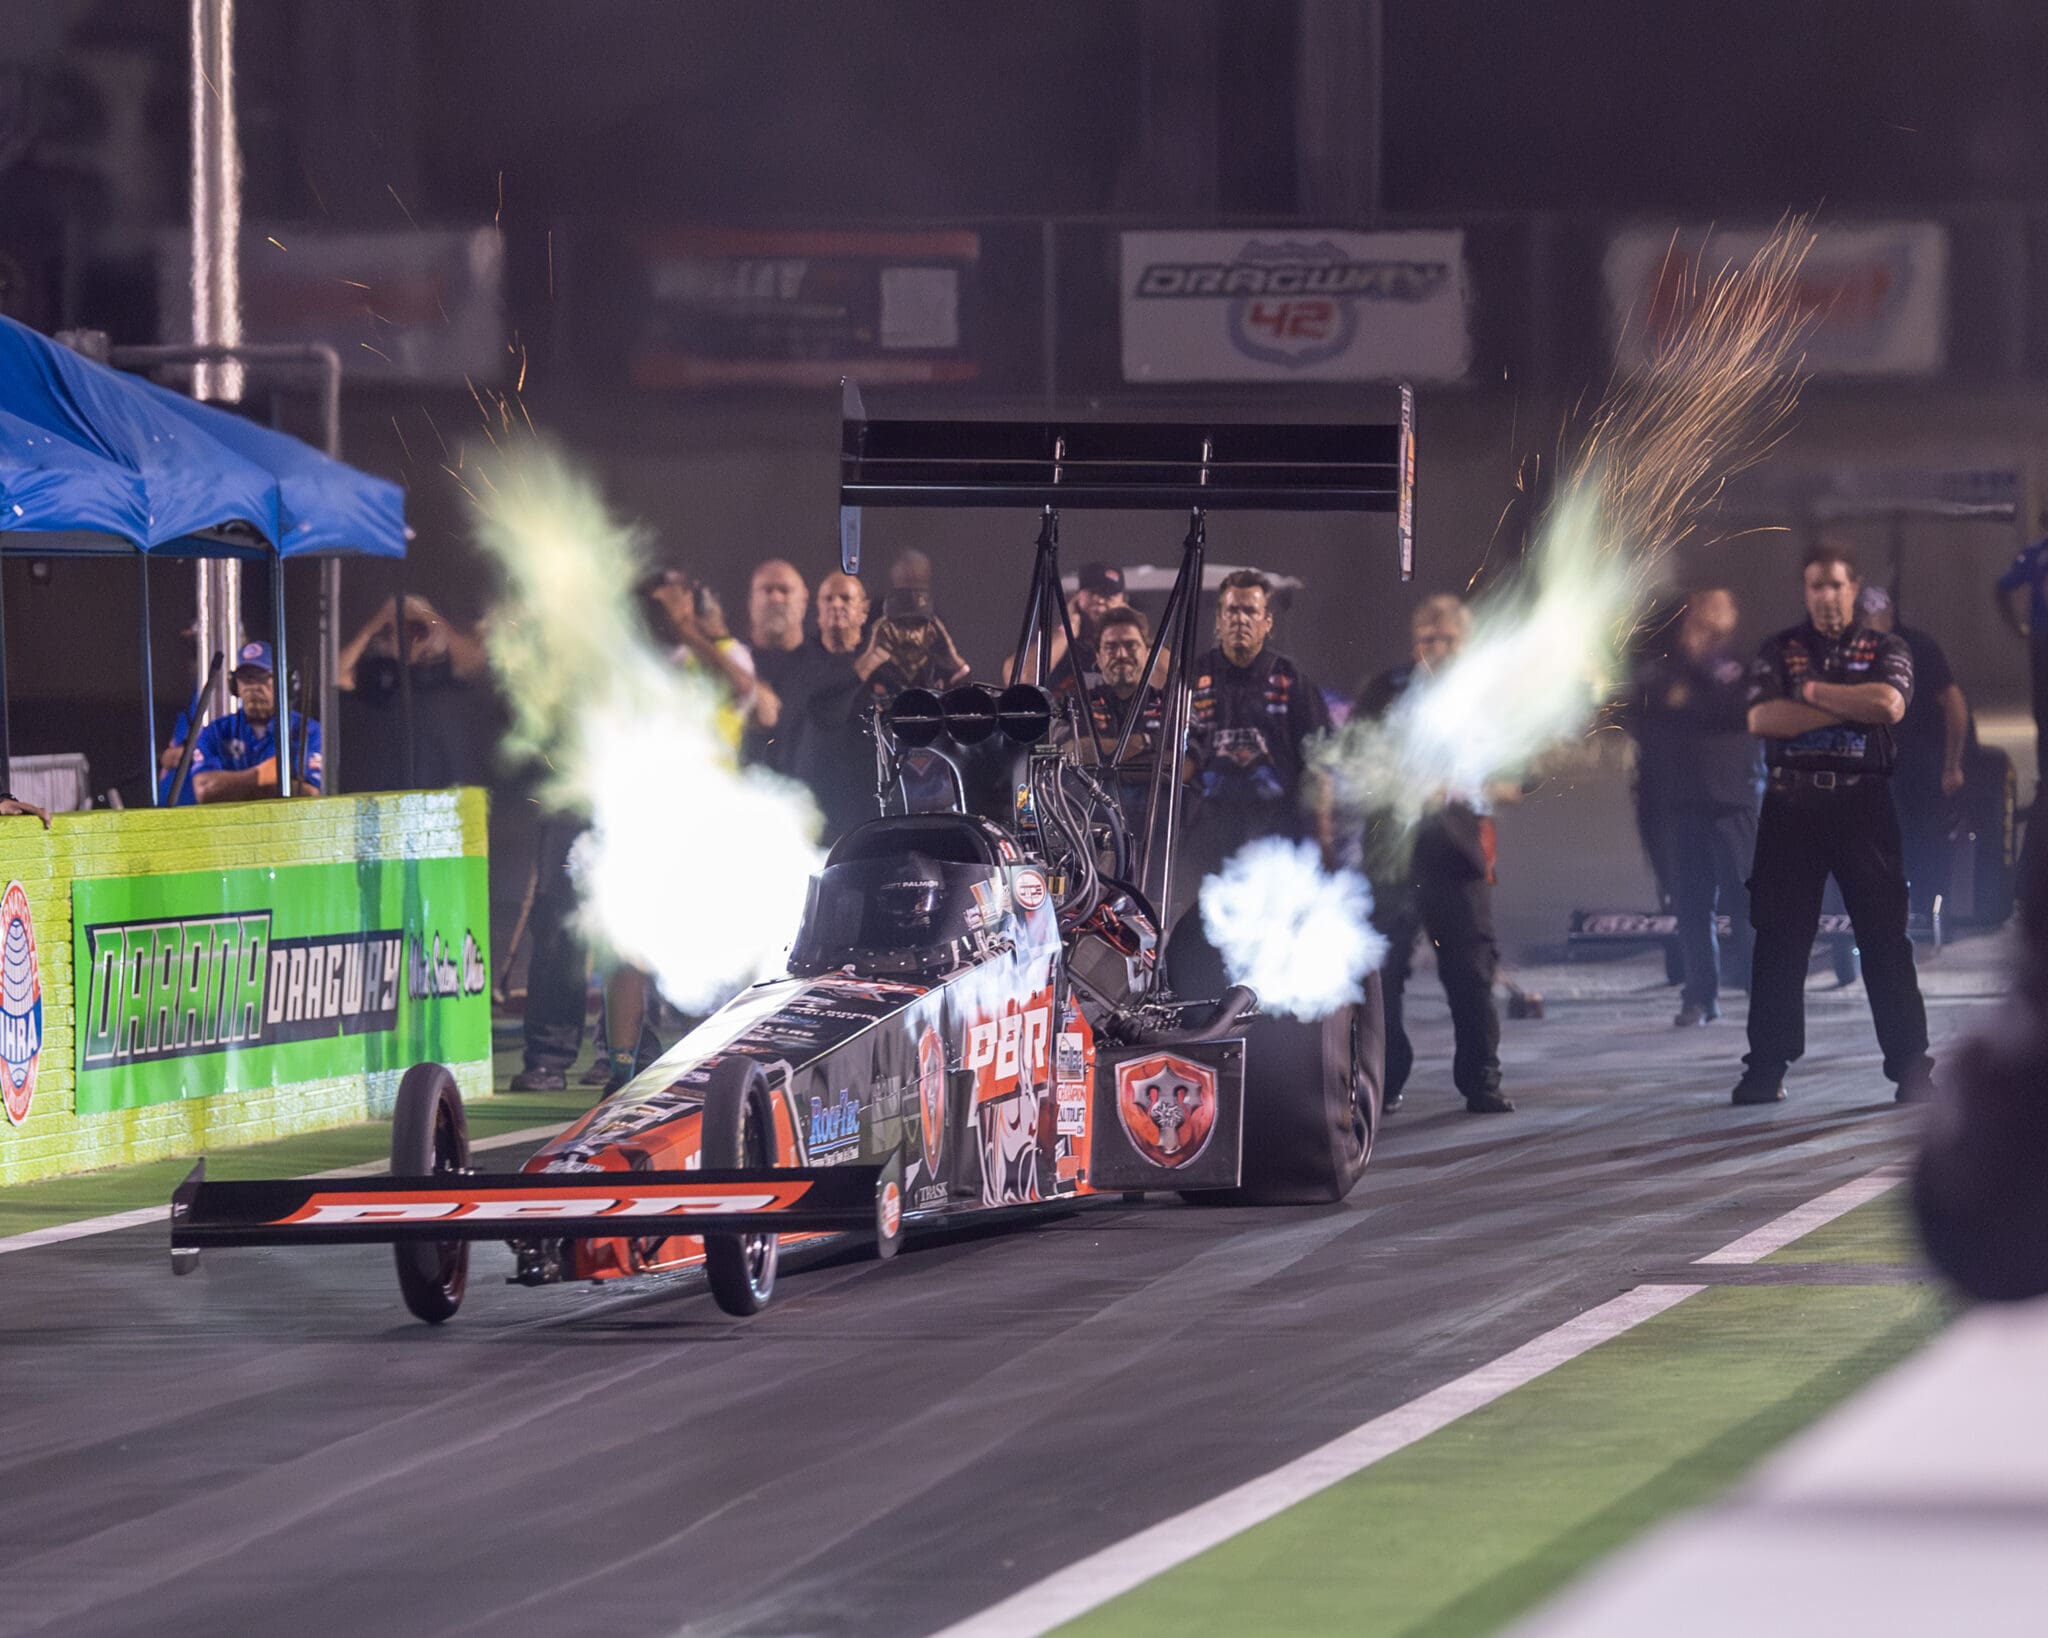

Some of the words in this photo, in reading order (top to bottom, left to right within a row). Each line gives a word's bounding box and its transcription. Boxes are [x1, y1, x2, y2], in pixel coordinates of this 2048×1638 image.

[1249, 300, 1335, 340] 42
[85, 912, 271, 1062] DARANA
[267, 938, 402, 1025] DRAGWAY
[0, 1007, 39, 1064] IHRA
[968, 1006, 1049, 1081] PBR
